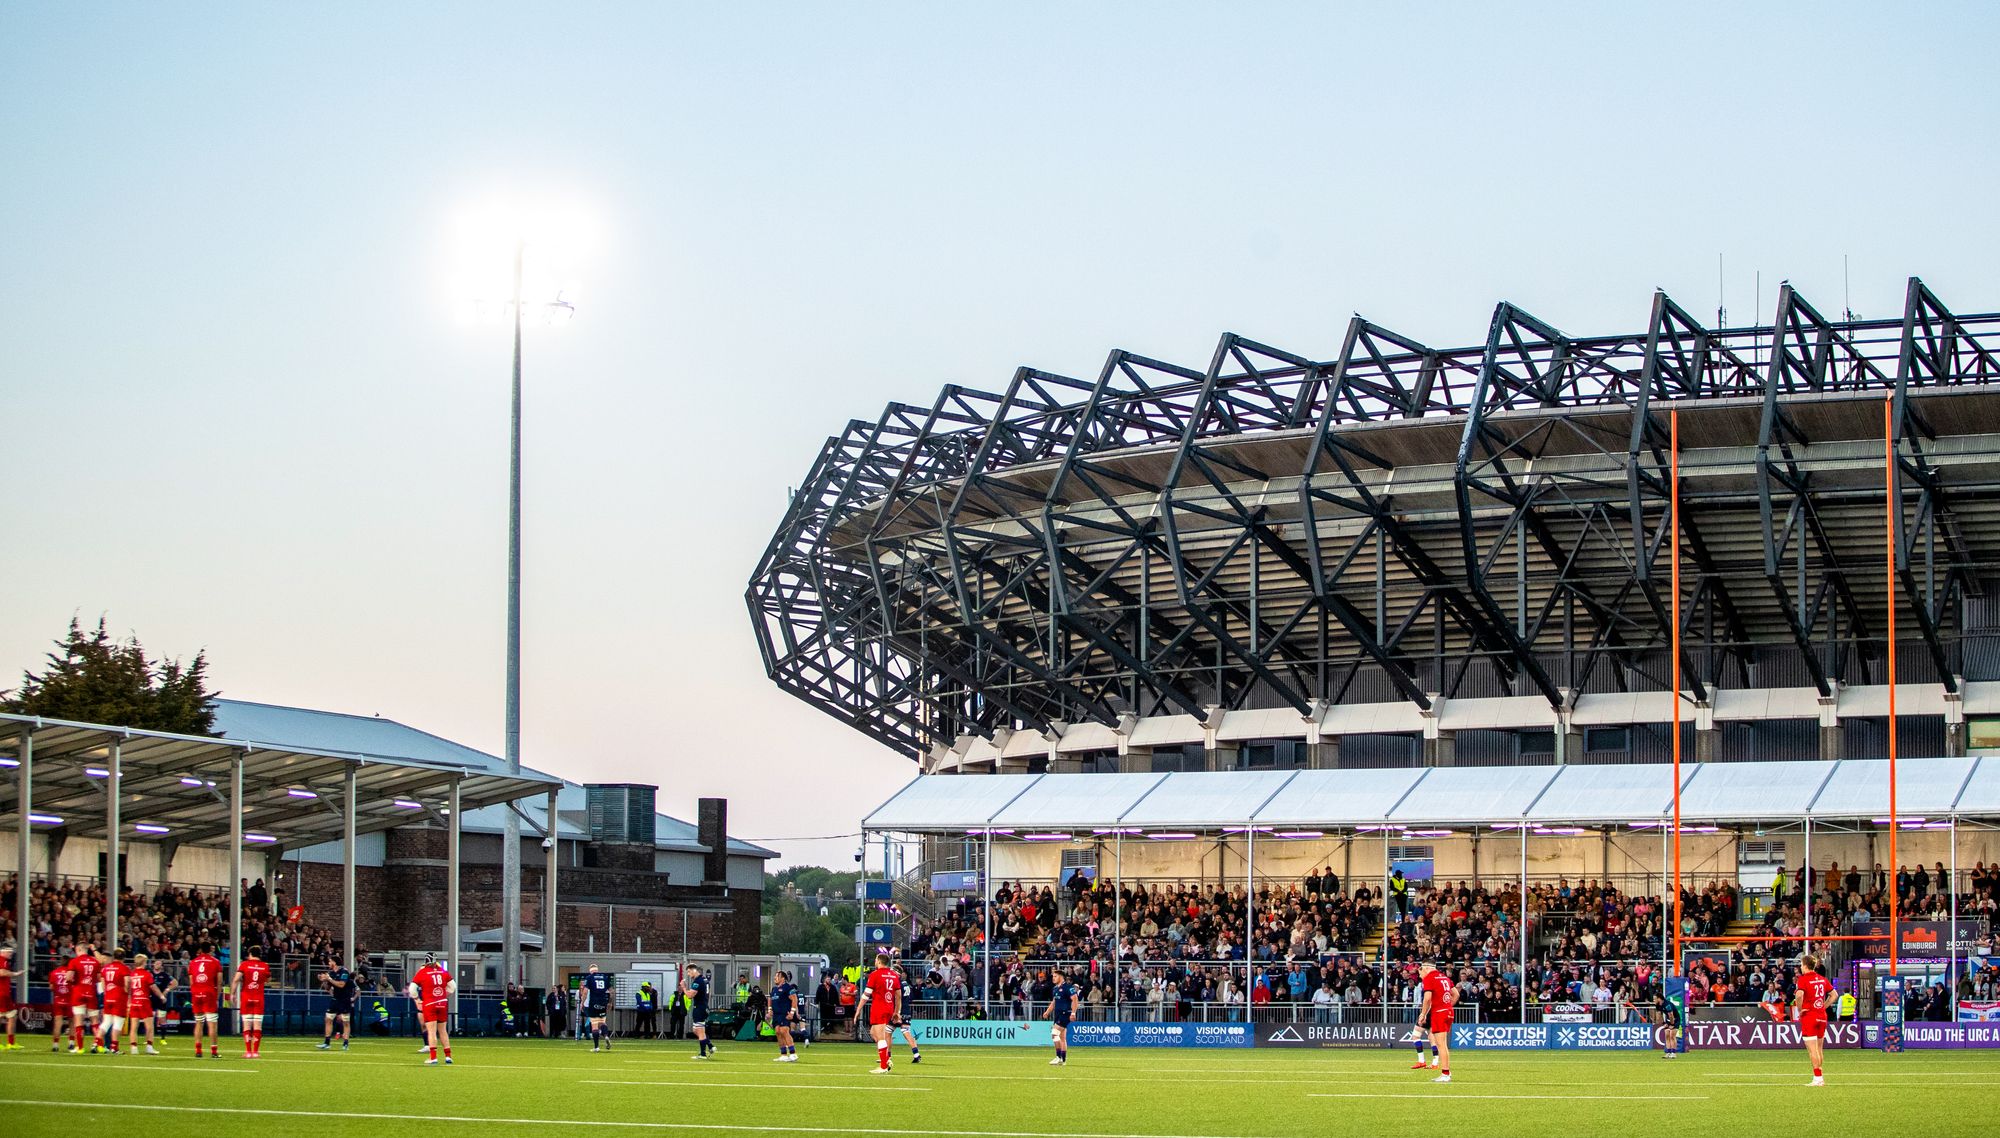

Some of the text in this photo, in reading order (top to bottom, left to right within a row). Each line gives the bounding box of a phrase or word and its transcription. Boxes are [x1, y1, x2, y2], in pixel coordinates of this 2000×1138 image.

[1864, 945, 1888, 954] HIVE
[1902, 942, 1937, 950] EDINBURGH
[198, 962, 205, 973] 6
[253, 971, 259, 981] 8
[432, 974, 443, 985] 18
[595, 979, 605, 989] 19
[885, 979, 894, 990] 12
[1440, 980, 1450, 991] 13
[1814, 983, 1824, 997] 23
[926, 1026, 1015, 1039] EDINBURGH GIN
[1073, 1026, 1103, 1034] VISION
[1196, 1027, 1226, 1035] VISION
[1308, 1027, 1396, 1040] BREADALBANE
[1475, 1027, 1547, 1039] SCOTTISH
[1578, 1027, 1650, 1039] SCOTTISH
[1945, 1028, 1965, 1042] THE
[1968, 1028, 1990, 1042] URC
[1072, 1034, 1121, 1043] SCOTLAND
[1134, 1035, 1183, 1044] SCOTLAND
[1195, 1035, 1245, 1044] SCOTLAND
[1475, 1039, 1547, 1047] BUILDING SOCIETY
[1578, 1039, 1650, 1047] BUILDING SOCIETY
